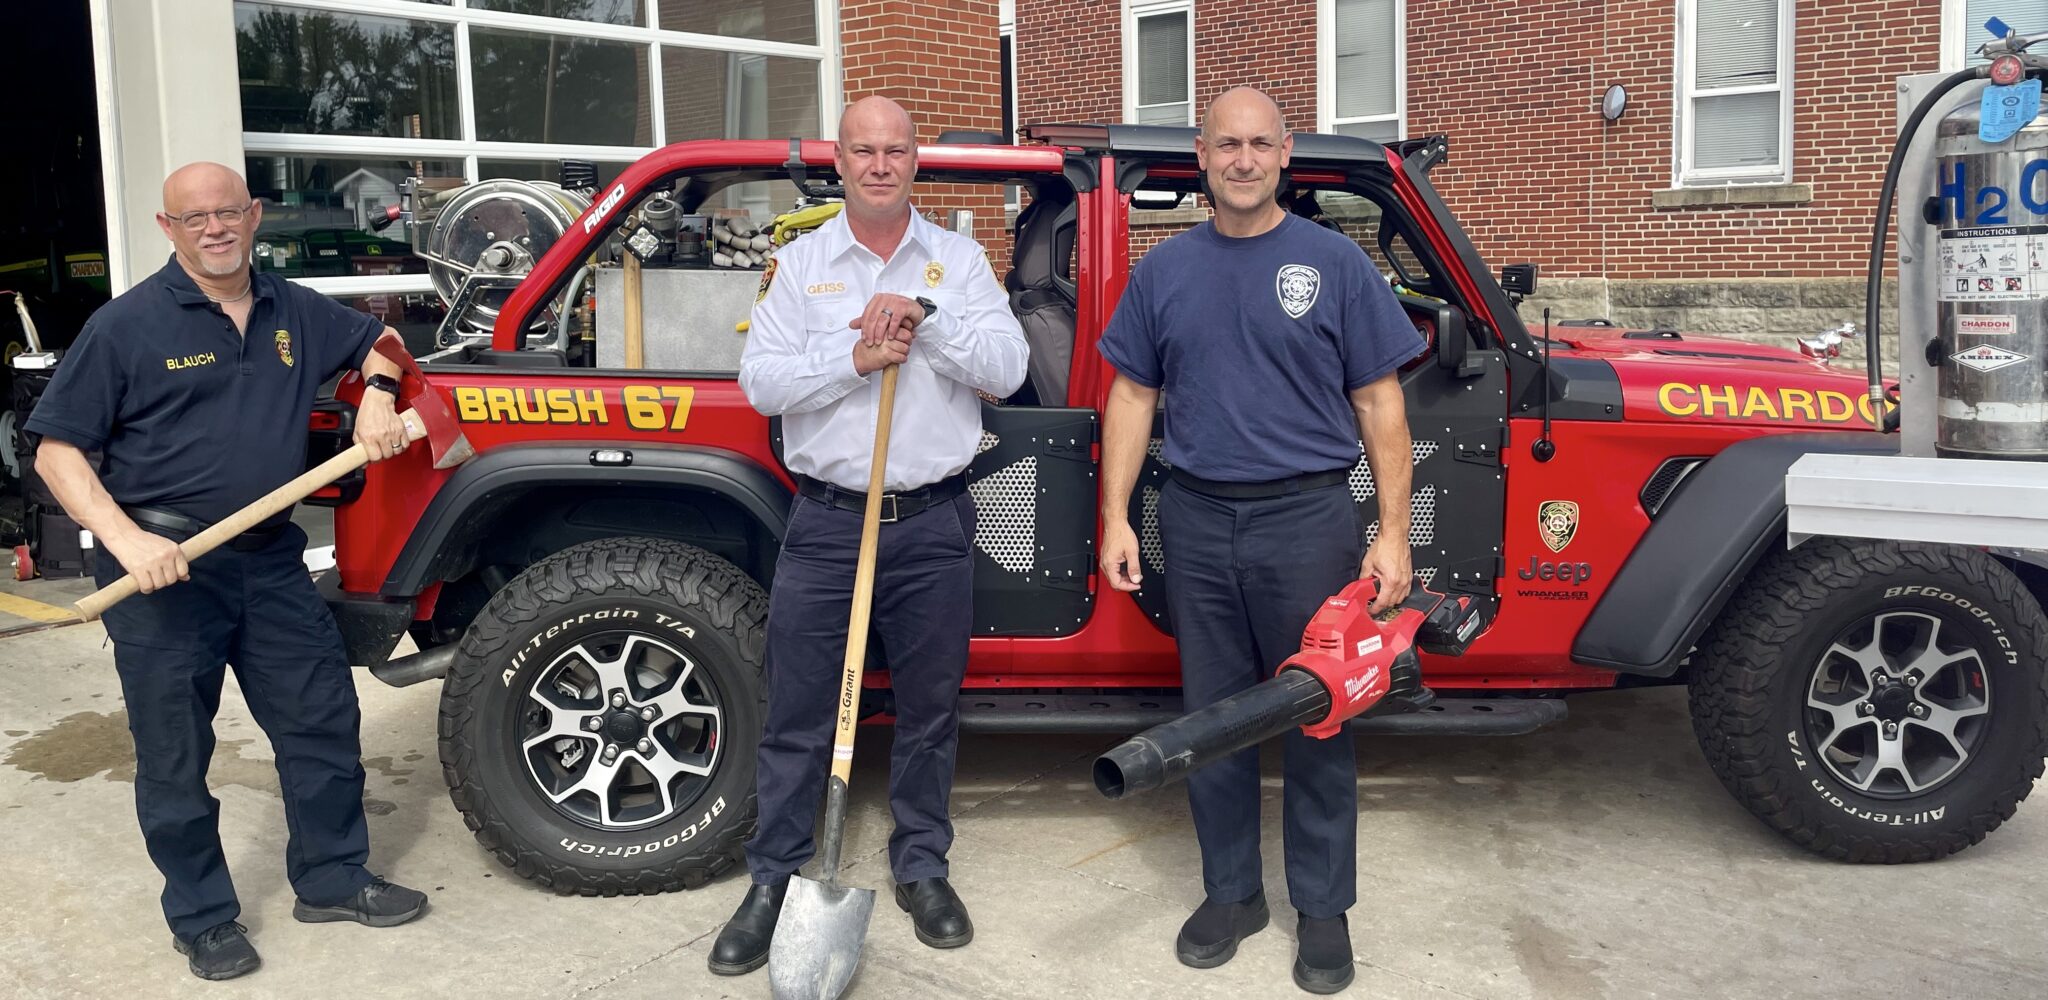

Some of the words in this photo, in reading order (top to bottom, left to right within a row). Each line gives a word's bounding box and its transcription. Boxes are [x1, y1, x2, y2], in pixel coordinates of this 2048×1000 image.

[583, 183, 626, 234] RIGID
[1957, 228, 2017, 237] INSTRUCTIONS
[807, 282, 846, 294] GEISS
[166, 351, 216, 370] BLAUCH
[453, 386, 609, 424] BRUSH
[623, 385, 695, 432] 67
[1518, 555, 1592, 586] Jeep
[1517, 590, 1589, 598] WRANGLER
[1883, 585, 2018, 665] BFGoodrich
[502, 607, 639, 688] All-Terrain
[655, 613, 696, 640] T/A
[842, 668, 855, 708] Garant
[1344, 665, 1379, 698] Milwaukee
[1787, 730, 1807, 771] T/A
[1810, 778, 1946, 826] All-Terrain
[560, 796, 727, 858] BFGoodrich
